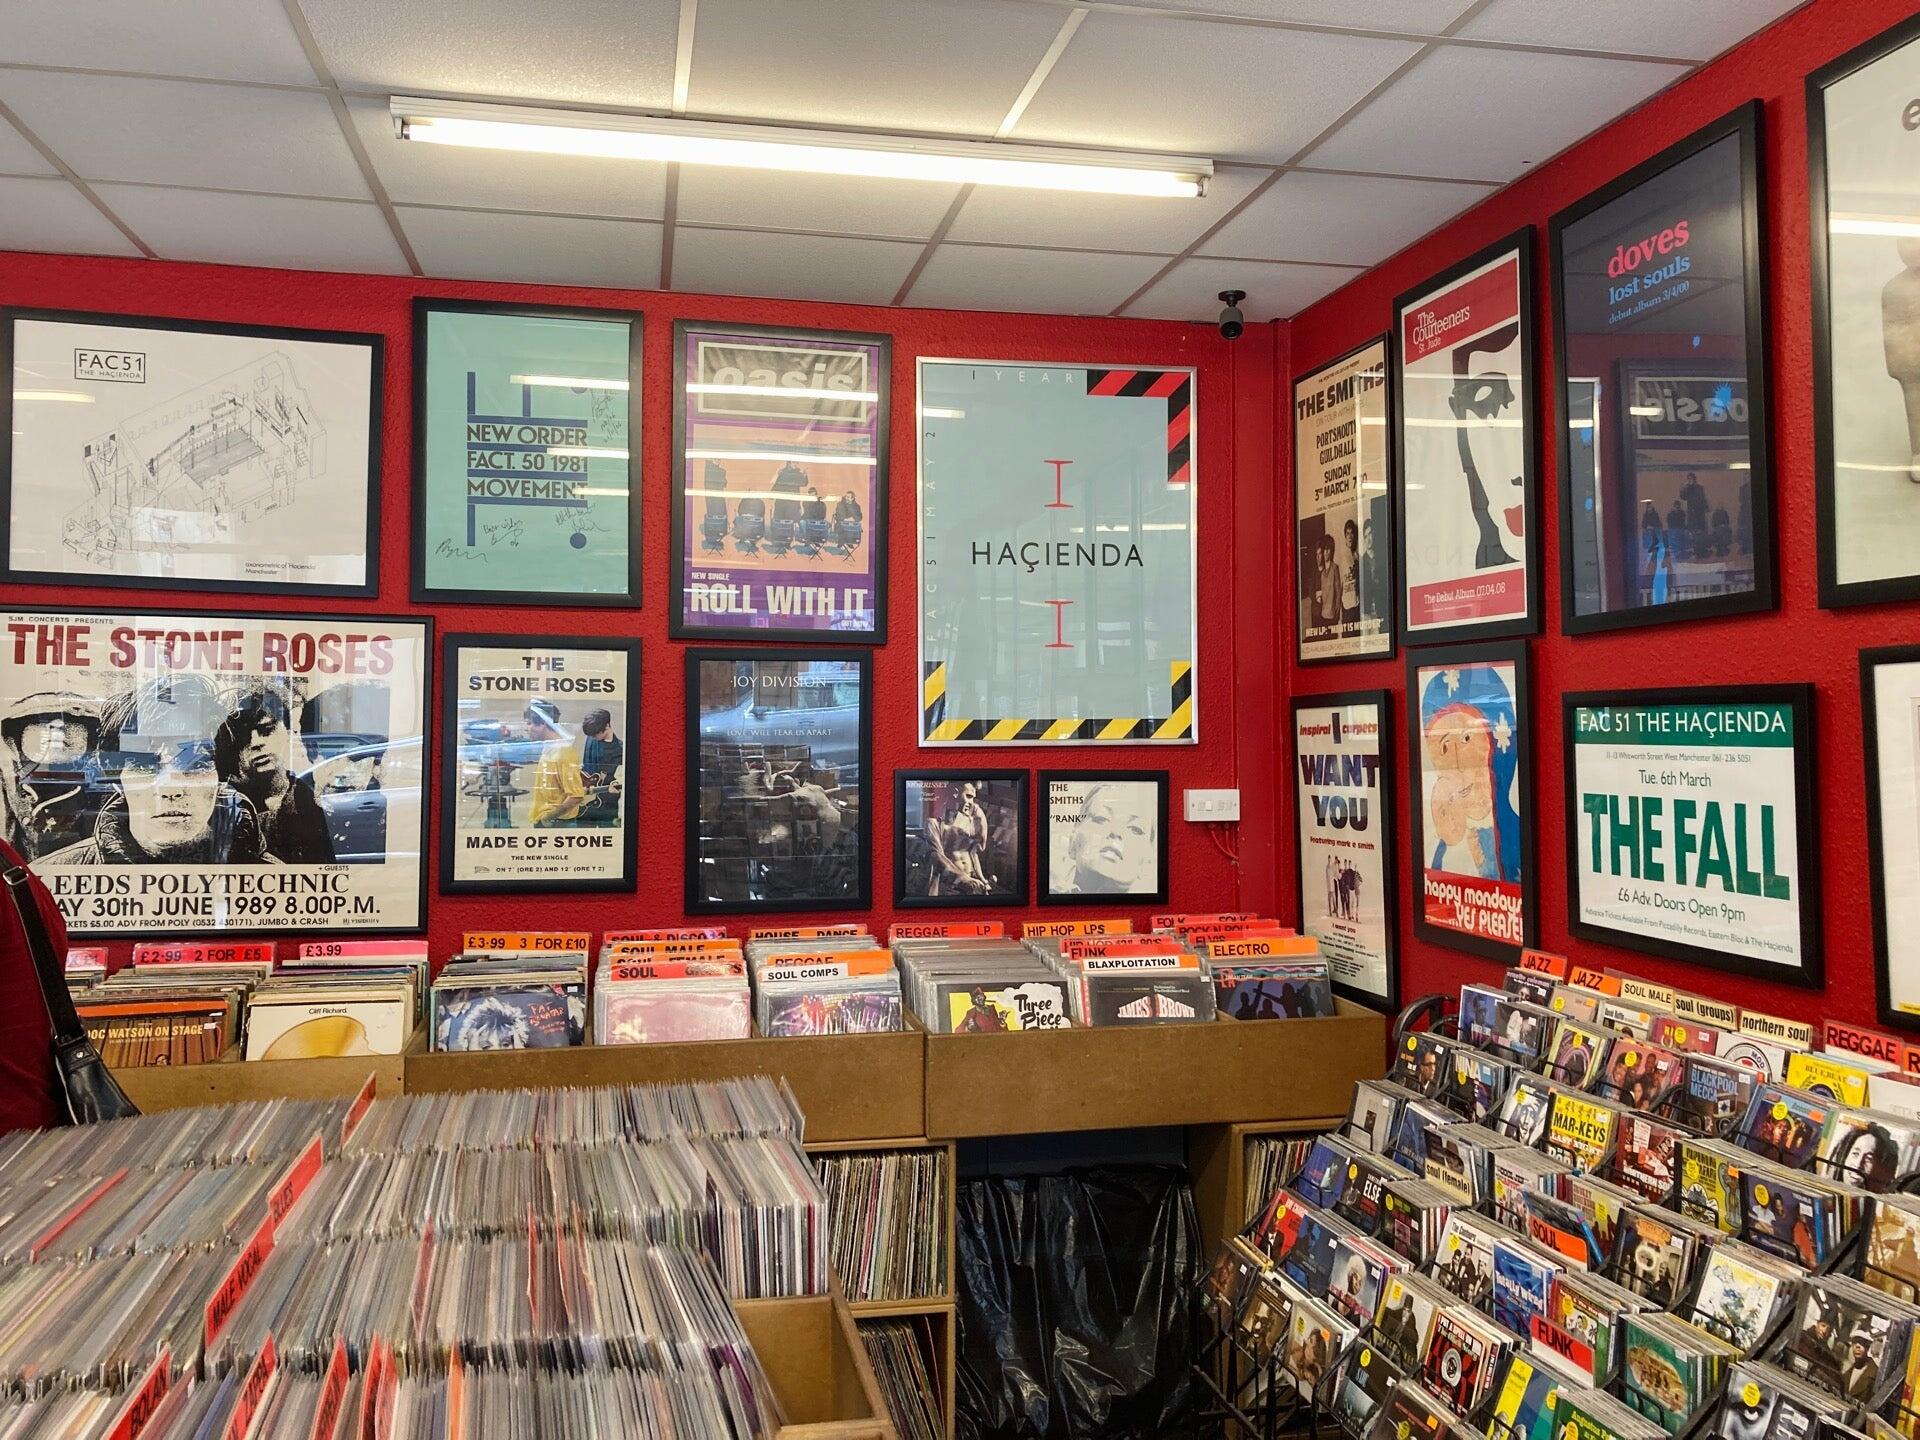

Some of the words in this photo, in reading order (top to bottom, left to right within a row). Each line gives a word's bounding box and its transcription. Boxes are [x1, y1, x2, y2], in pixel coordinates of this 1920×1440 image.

[1608, 220, 1690, 278] doves
[1609, 276, 1640, 305] lost
[1643, 255, 1691, 289] souls
[1609, 307, 1632, 325] debut
[1633, 295, 1661, 314] album
[1662, 280, 1690, 302] 3/4/00
[1413, 305, 1470, 345] Courteeners
[1418, 311, 1435, 329] The
[1427, 336, 1442, 350] Jude
[99, 370, 141, 379] HAÇIENDA
[712, 362, 854, 397] oasis
[993, 370, 1074, 384] YEAR
[1298, 390, 1325, 421] THE
[467, 424, 514, 442] NEW
[517, 426, 588, 446] ORDER
[467, 451, 516, 470] FACT.
[522, 453, 545, 470] 50
[551, 455, 588, 472] 1981
[1320, 439, 1357, 466] GUILDHALL
[1324, 462, 1352, 484] SUNDAY
[467, 479, 588, 500] MOVEMENT
[1324, 479, 1350, 499] MARCH
[972, 541, 1144, 573] HAÇIENDA
[691, 572, 706, 580] NEW
[708, 573, 730, 581] SINGLE
[691, 583, 757, 614] ROLL
[766, 585, 836, 616] WITH
[844, 588, 868, 617] IT
[1424, 594, 1435, 605] The
[1436, 591, 1454, 603] Debut
[1455, 588, 1476, 600] Album
[75, 617, 114, 625] PRESENTS
[8, 624, 90, 666] THE
[109, 626, 244, 672] STONE
[262, 632, 394, 675] ROSES
[522, 656, 565, 672] THE
[468, 677, 540, 692] STONE
[545, 677, 615, 693] ROSES
[731, 676, 758, 688] JOY
[762, 676, 826, 688] DIVISION
[727, 729, 748, 737] LOVE
[806, 728, 833, 736] APART
[1300, 723, 1331, 738] inspiral
[1342, 722, 1378, 736] carpets
[1332, 712, 1342, 745] I
[1580, 712, 1611, 733] FAC
[1615, 712, 1630, 733] 51
[1636, 712, 1670, 733] THE
[1675, 710, 1787, 739] HAÇIENDA
[1300, 754, 1379, 788] WANT
[1638, 769, 1658, 785] Tue.
[1660, 770, 1677, 786] 6th
[1679, 771, 1712, 787] March
[1050, 783, 1069, 792] THE
[1050, 796, 1084, 805] SMITHS
[1311, 795, 1368, 832] YOU
[466, 836, 518, 848] MADE
[525, 836, 548, 848] OF
[554, 835, 613, 848] STONE
[1583, 793, 1665, 882] THE
[1673, 798, 1790, 900] FALL
[140, 873, 350, 894] POLYTECHNIC
[1424, 873, 1462, 906] happy
[1464, 886, 1523, 914] mondays
[92, 897, 144, 917] 30th
[152, 896, 213, 916] JUNE
[226, 895, 277, 915] 1989
[285, 895, 381, 915] 8.00P.M.
[1618, 887, 1630, 902] £6
[1631, 889, 1651, 906] Adv.
[1654, 892, 1686, 912] Doors
[1688, 898, 1718, 920] Open
[1720, 903, 1746, 924] 9pm
[90, 920, 115, 928] £5.00
[168, 919, 190, 927] POLY
[192, 918, 216, 927] (0532
[257, 918, 289, 926] JUMBO
[300, 917, 329, 925] CRASH
[895, 926, 949, 939] REGGAE
[976, 925, 992, 937] LP
[1027, 925, 1047, 937] HIP
[1049, 924, 1076, 936] HOP
[1084, 923, 1106, 935] LPS
[1157, 916, 1186, 929] FOLK
[519, 937, 528, 950] 3
[535, 937, 563, 950] FOR
[565, 937, 587, 950] £10
[754, 930, 800, 939] HOUSE
[194, 949, 204, 962] 2
[207, 948, 236, 962] FOR
[243, 947, 262, 961] £5
[305, 943, 343, 957] £3.99
[665, 944, 705, 954] MALE
[1071, 947, 1107, 959] FUNK
[1213, 943, 1270, 957] ELECTRO
[619, 966, 658, 979] SOUL
[1088, 958, 1176, 969] BLAXPLOITATION
[1524, 955, 1551, 974] JAZZ
[768, 970, 798, 981] SOUL
[800, 967, 840, 979] COMPS
[1573, 970, 1604, 990] JAZZ
[1013, 993, 1053, 1012] Three
[1624, 983, 1646, 1000] SOUL
[1648, 989, 1672, 1004] MALE
[308, 1006, 321, 1015] Cliff
[1117, 995, 1153, 1018] JAMES
[1154, 992, 1196, 1018] BROWN
[1675, 997, 1694, 1013] soul
[1696, 1001, 1735, 1024] (groups)
[1020, 1010, 1062, 1030] Piece
[1742, 1015, 1785, 1037] northern
[1787, 1026, 1809, 1042] soul
[108, 1026, 153, 1039] WATSON
[155, 1025, 170, 1038] ON
[171, 1024, 203, 1037] STAGE
[1826, 1025, 1897, 1063] REGGAE
[1690, 1081, 1718, 1103] MECCA
[1691, 1068, 1738, 1096] BLACKPOOL
[1553, 1111, 1606, 1143] MAR-KEYS
[1427, 1163, 1441, 1180] soul
[1442, 1169, 1471, 1195] (female)
[1363, 1180, 1382, 1204] ELSE
[1533, 1219, 1561, 1252] SOUL
[1537, 1319, 1575, 1362] FUNK
